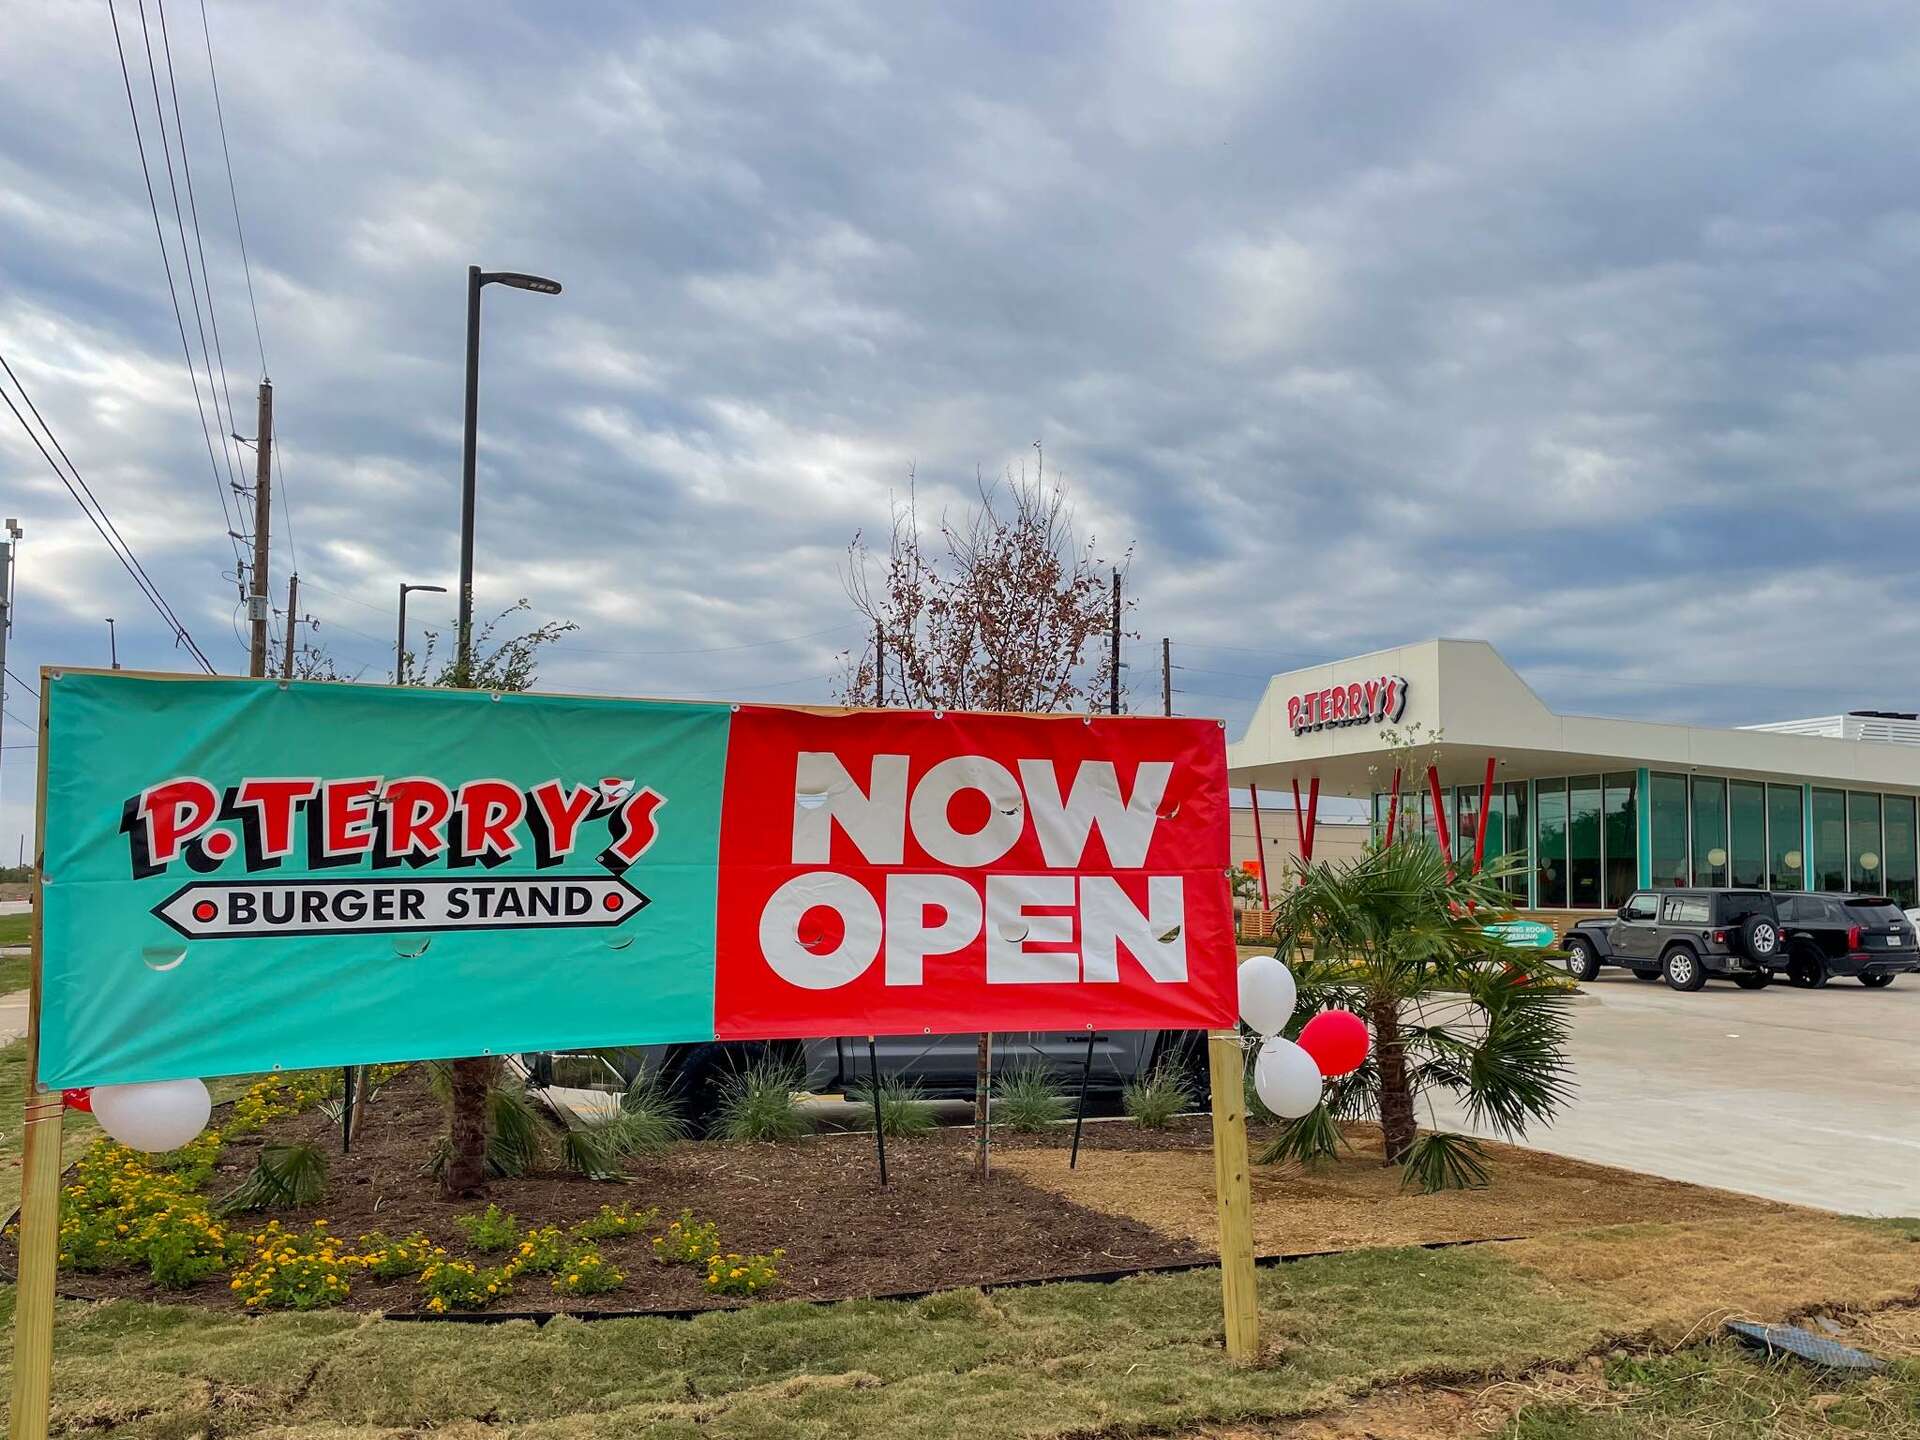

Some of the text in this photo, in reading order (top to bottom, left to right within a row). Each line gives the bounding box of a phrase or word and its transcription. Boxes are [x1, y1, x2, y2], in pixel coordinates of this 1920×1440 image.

[1287, 675, 1400, 729] P.TERRY'S
[133, 775, 668, 869] P.TERRY'S
[791, 751, 1175, 869] NOW
[228, 886, 593, 925] BURGER STAND
[758, 871, 1189, 990] OPEN
[1526, 926, 1547, 934] ROOM
